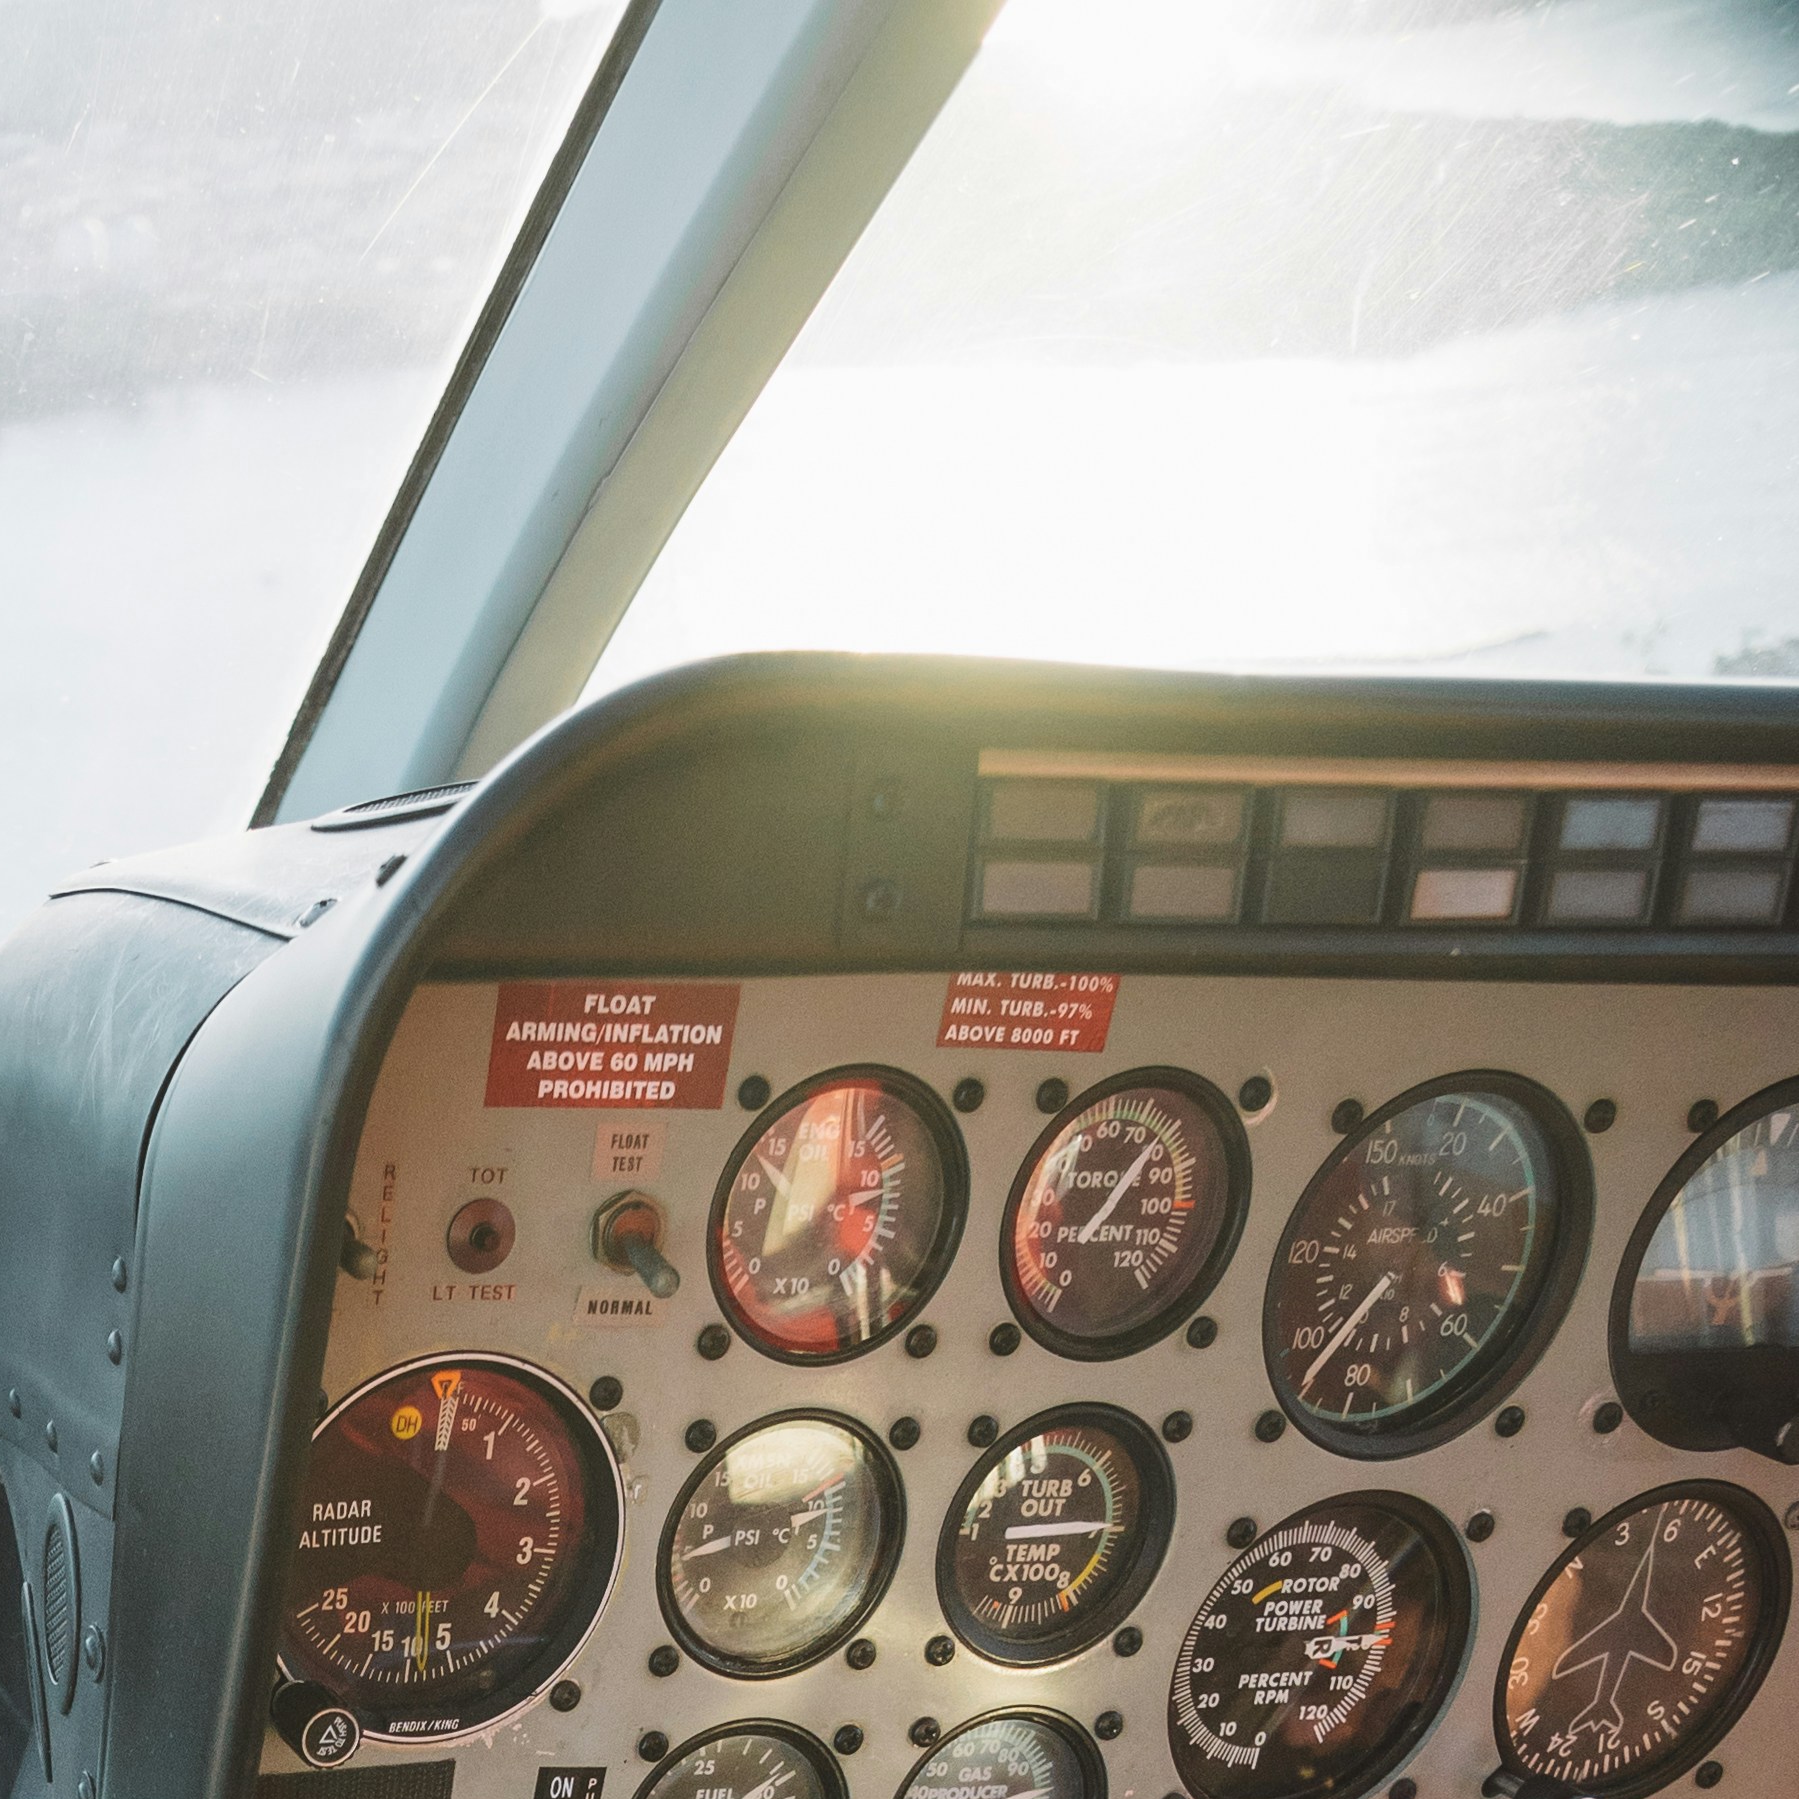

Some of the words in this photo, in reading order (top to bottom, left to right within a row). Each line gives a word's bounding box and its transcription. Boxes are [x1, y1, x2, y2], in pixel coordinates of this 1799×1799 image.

[957, 973, 1001, 987] MAX.
[1010, 973, 1113, 993] TURB.-100%
[584, 994, 656, 1015] FLOAT
[951, 998, 991, 1015] MIN.
[1000, 1000, 1093, 1019] TURB.-97%
[506, 1022, 723, 1045] ARMING/INFLATION
[944, 1025, 1006, 1042] ABOVE
[1011, 1028, 1053, 1045] 8000
[1059, 1029, 1080, 1045] FT
[526, 1051, 604, 1071] ABOVE
[610, 1053, 638, 1072] 60
[644, 1053, 694, 1072] MPH
[537, 1080, 676, 1100] PROHIBITED
[1097, 1121, 1120, 1138] 60
[1124, 1127, 1146, 1144] 70
[611, 1134, 649, 1149] FLOAT
[768, 1138, 787, 1156] 15
[1366, 1140, 1398, 1164] 150
[612, 1157, 643, 1172] TEST
[470, 1168, 508, 1184] TOT
[1141, 1199, 1171, 1215] 100
[1477, 1194, 1506, 1216] 40
[432, 1286, 456, 1300] LT
[470, 1284, 516, 1300] TEST
[588, 1300, 652, 1315] NORMAL
[1344, 1364, 1370, 1387] 80
[396, 1416, 418, 1432] DH
[1078, 1468, 1091, 1486] 6
[1022, 1479, 1073, 1497] TURB
[313, 1500, 371, 1521] RADAR
[1021, 1499, 1067, 1516] OUT
[299, 1525, 382, 1549] ALTITUDE
[1006, 1544, 1060, 1562] TEMP
[1281, 1577, 1340, 1594] ROTOR
[322, 1588, 348, 1610] 25
[484, 1592, 500, 1618] 4
[1264, 1600, 1323, 1616] POWER
[1352, 1595, 1375, 1609] 90
[1255, 1615, 1327, 1632] TURBINE
[1238, 1671, 1313, 1689] PERCENT
[1254, 1689, 1289, 1705] RPM
[1299, 1705, 1328, 1721] 120
[389, 1719, 460, 1733] BENDIX/KING
[959, 1766, 992, 1782] GAS
[550, 1777, 574, 1799] ON
